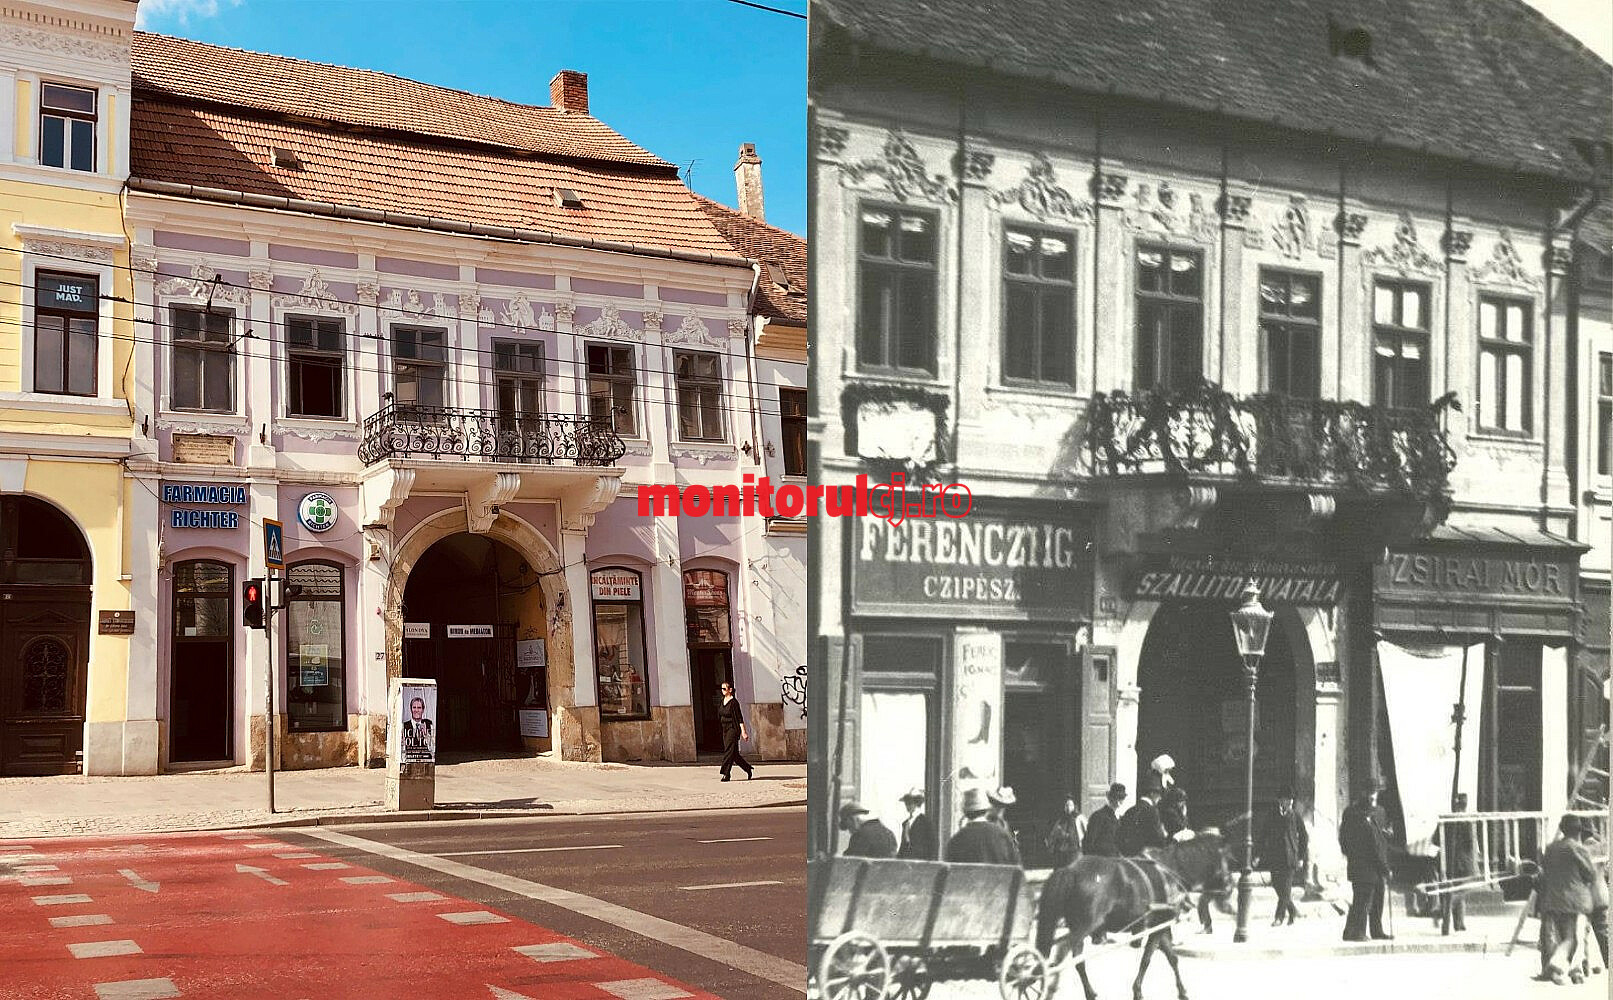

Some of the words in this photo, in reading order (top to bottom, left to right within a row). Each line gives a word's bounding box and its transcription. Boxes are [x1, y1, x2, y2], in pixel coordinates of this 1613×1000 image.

[57, 284, 82, 294] JUST
[56, 292, 82, 302] MAD.
[163, 484, 247, 504] FARMACIA
[172, 509, 239, 528] RICHTER
[1392, 553, 1489, 588] ZSIRAI
[599, 587, 611, 596] DIN
[613, 587, 631, 596] PIELE
[376, 652, 385, 660] 27
